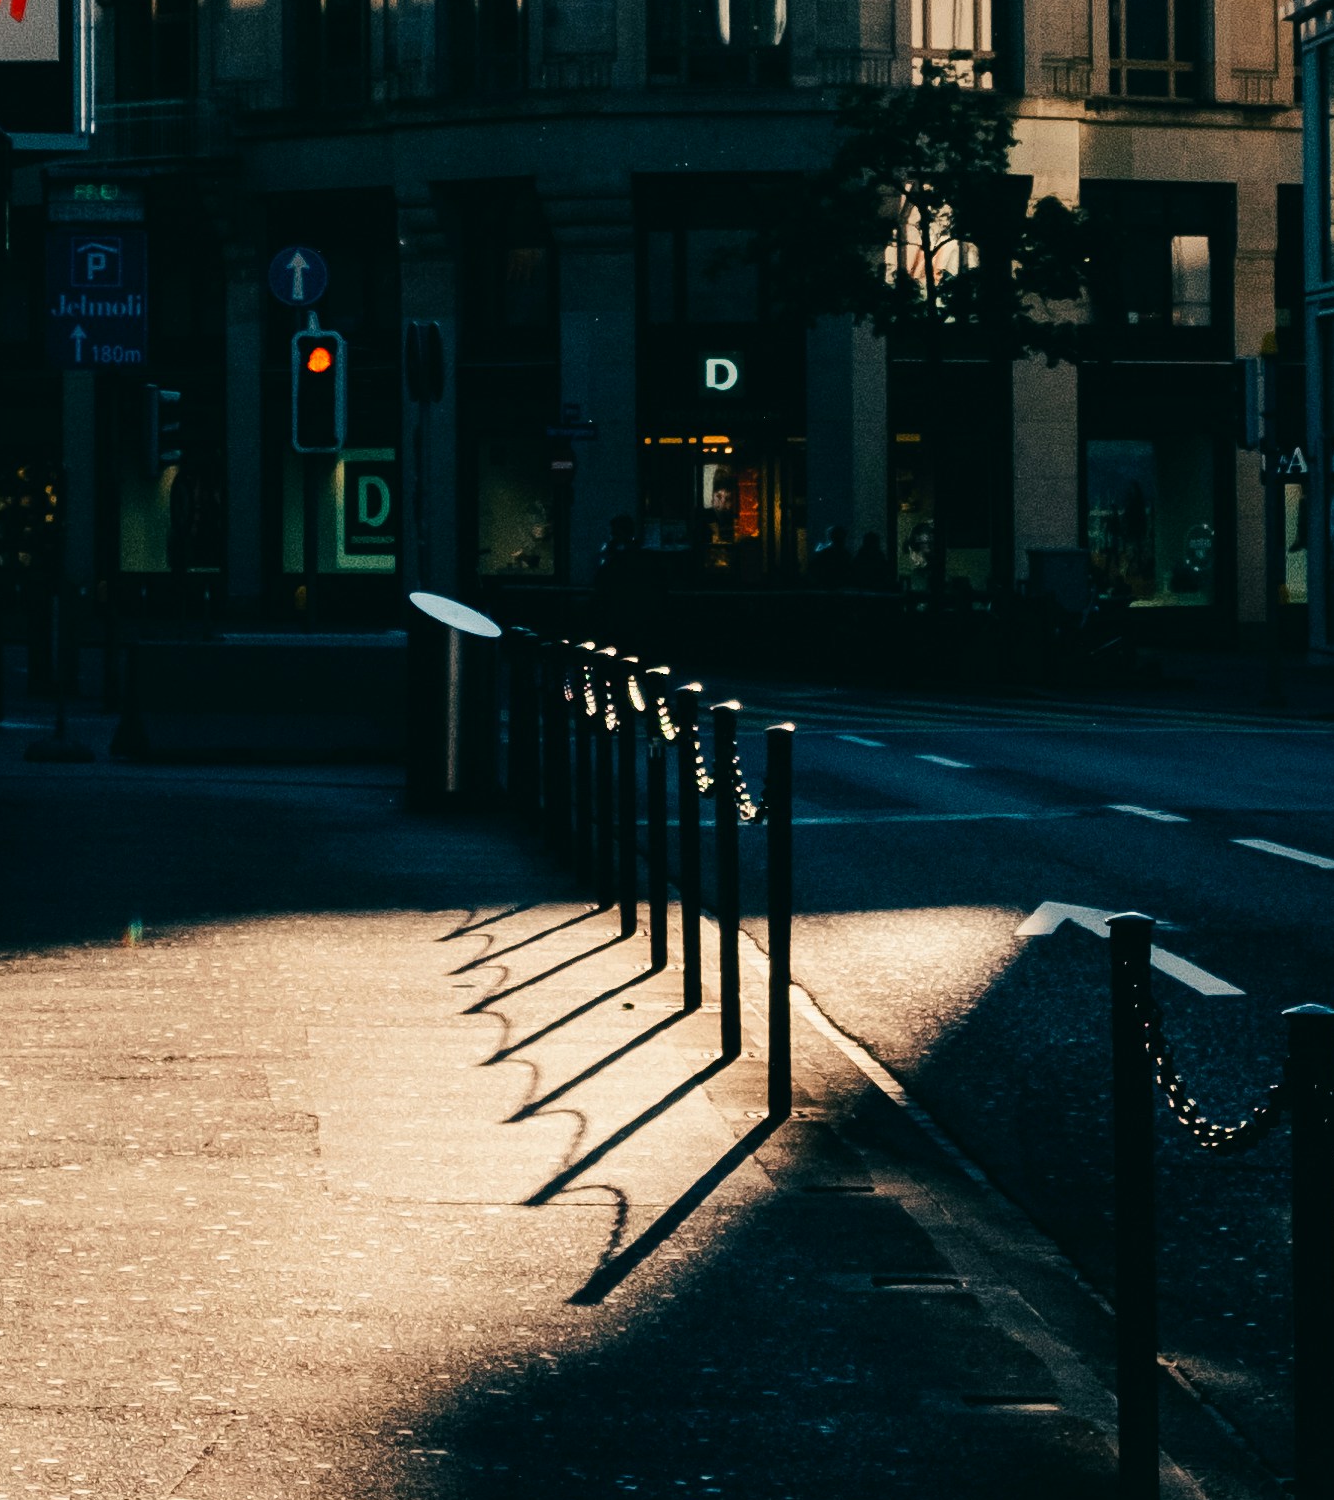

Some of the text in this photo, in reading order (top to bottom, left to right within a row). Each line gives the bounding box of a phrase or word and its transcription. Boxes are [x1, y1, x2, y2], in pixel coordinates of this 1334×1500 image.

[86, 252, 107, 281] P
[50, 293, 143, 317] Jelmoli
[92, 344, 142, 363] 180m
[705, 357, 738, 391] D
[357, 474, 391, 528] D
